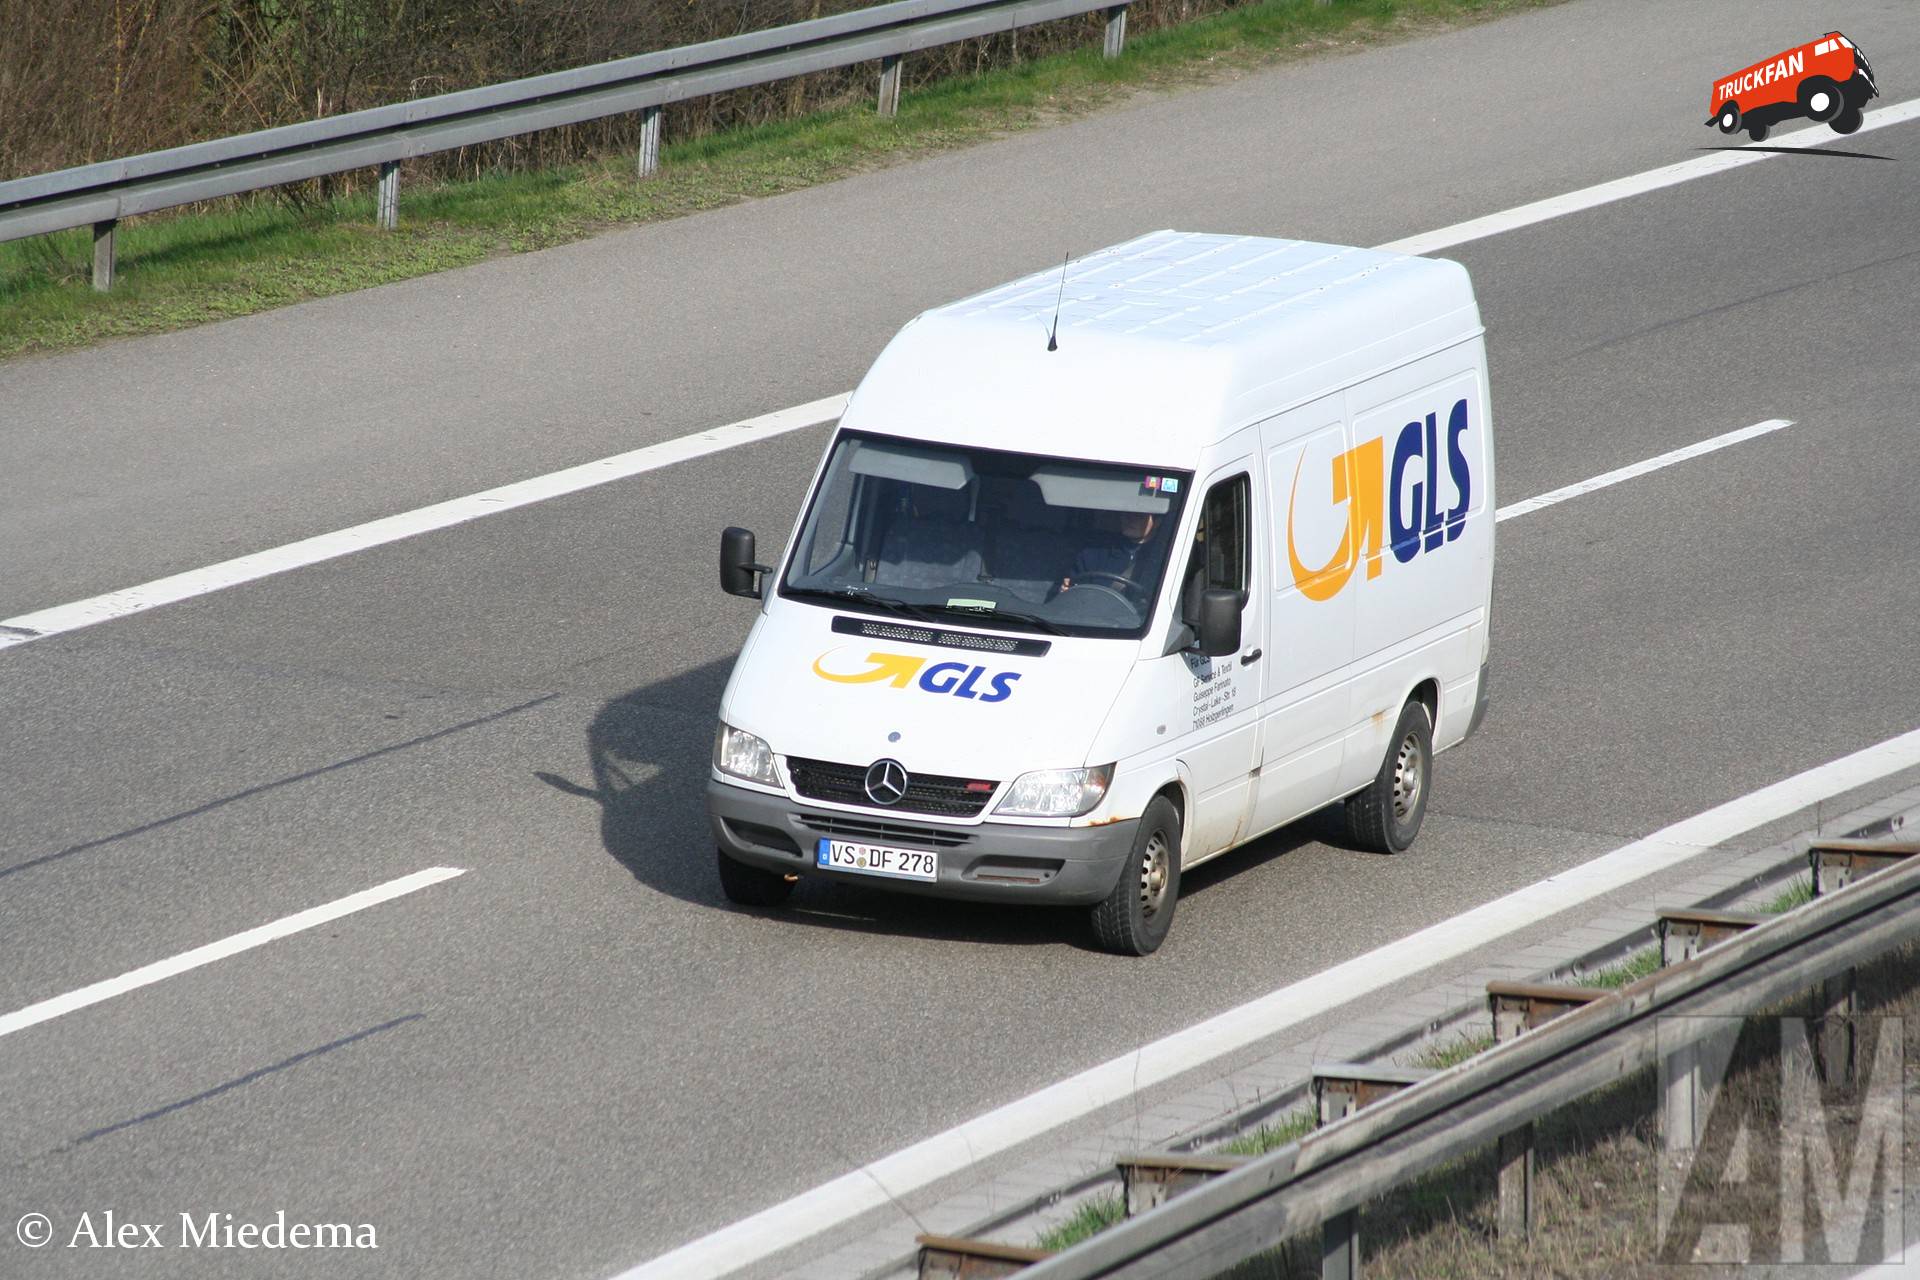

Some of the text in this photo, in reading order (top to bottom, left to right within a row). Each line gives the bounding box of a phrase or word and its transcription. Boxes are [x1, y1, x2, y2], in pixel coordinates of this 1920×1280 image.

[1389, 398, 1471, 563] GLS
[918, 661, 1022, 703] GLS
[832, 844, 855, 864] VS
[869, 848, 894, 868] DF
[898, 852, 934, 874] 278
